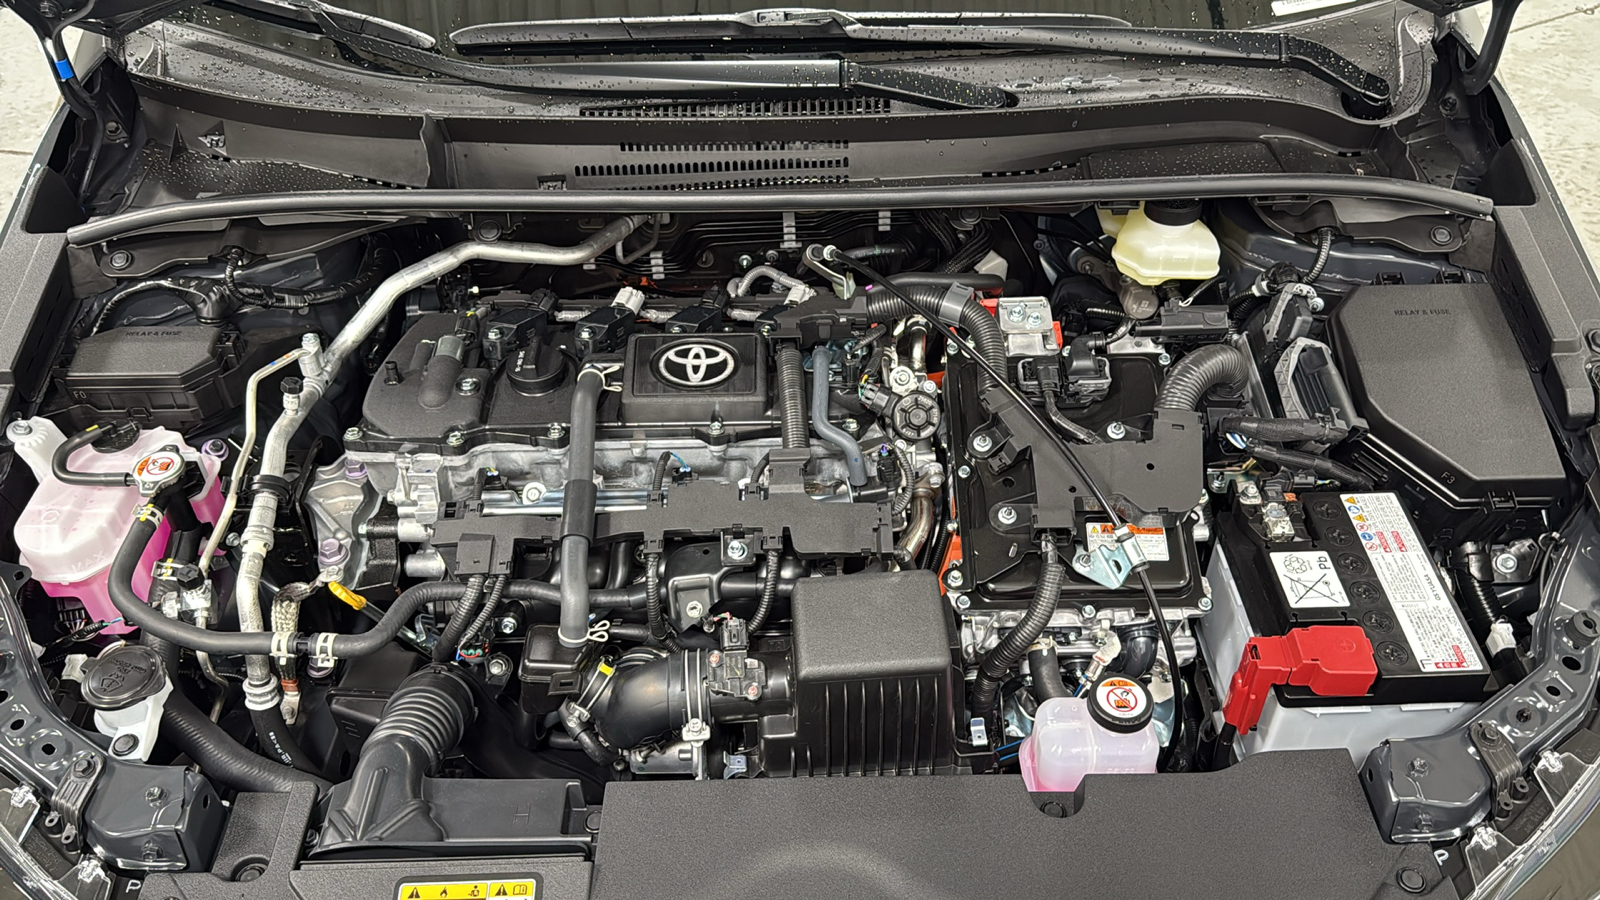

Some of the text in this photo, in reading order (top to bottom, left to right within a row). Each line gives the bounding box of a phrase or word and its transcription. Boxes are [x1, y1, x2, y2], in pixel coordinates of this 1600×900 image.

[1440, 471, 1456, 485] F3
[1316, 555, 1331, 570] Pb
[1434, 849, 1449, 866] P
[125, 879, 141, 893] P
